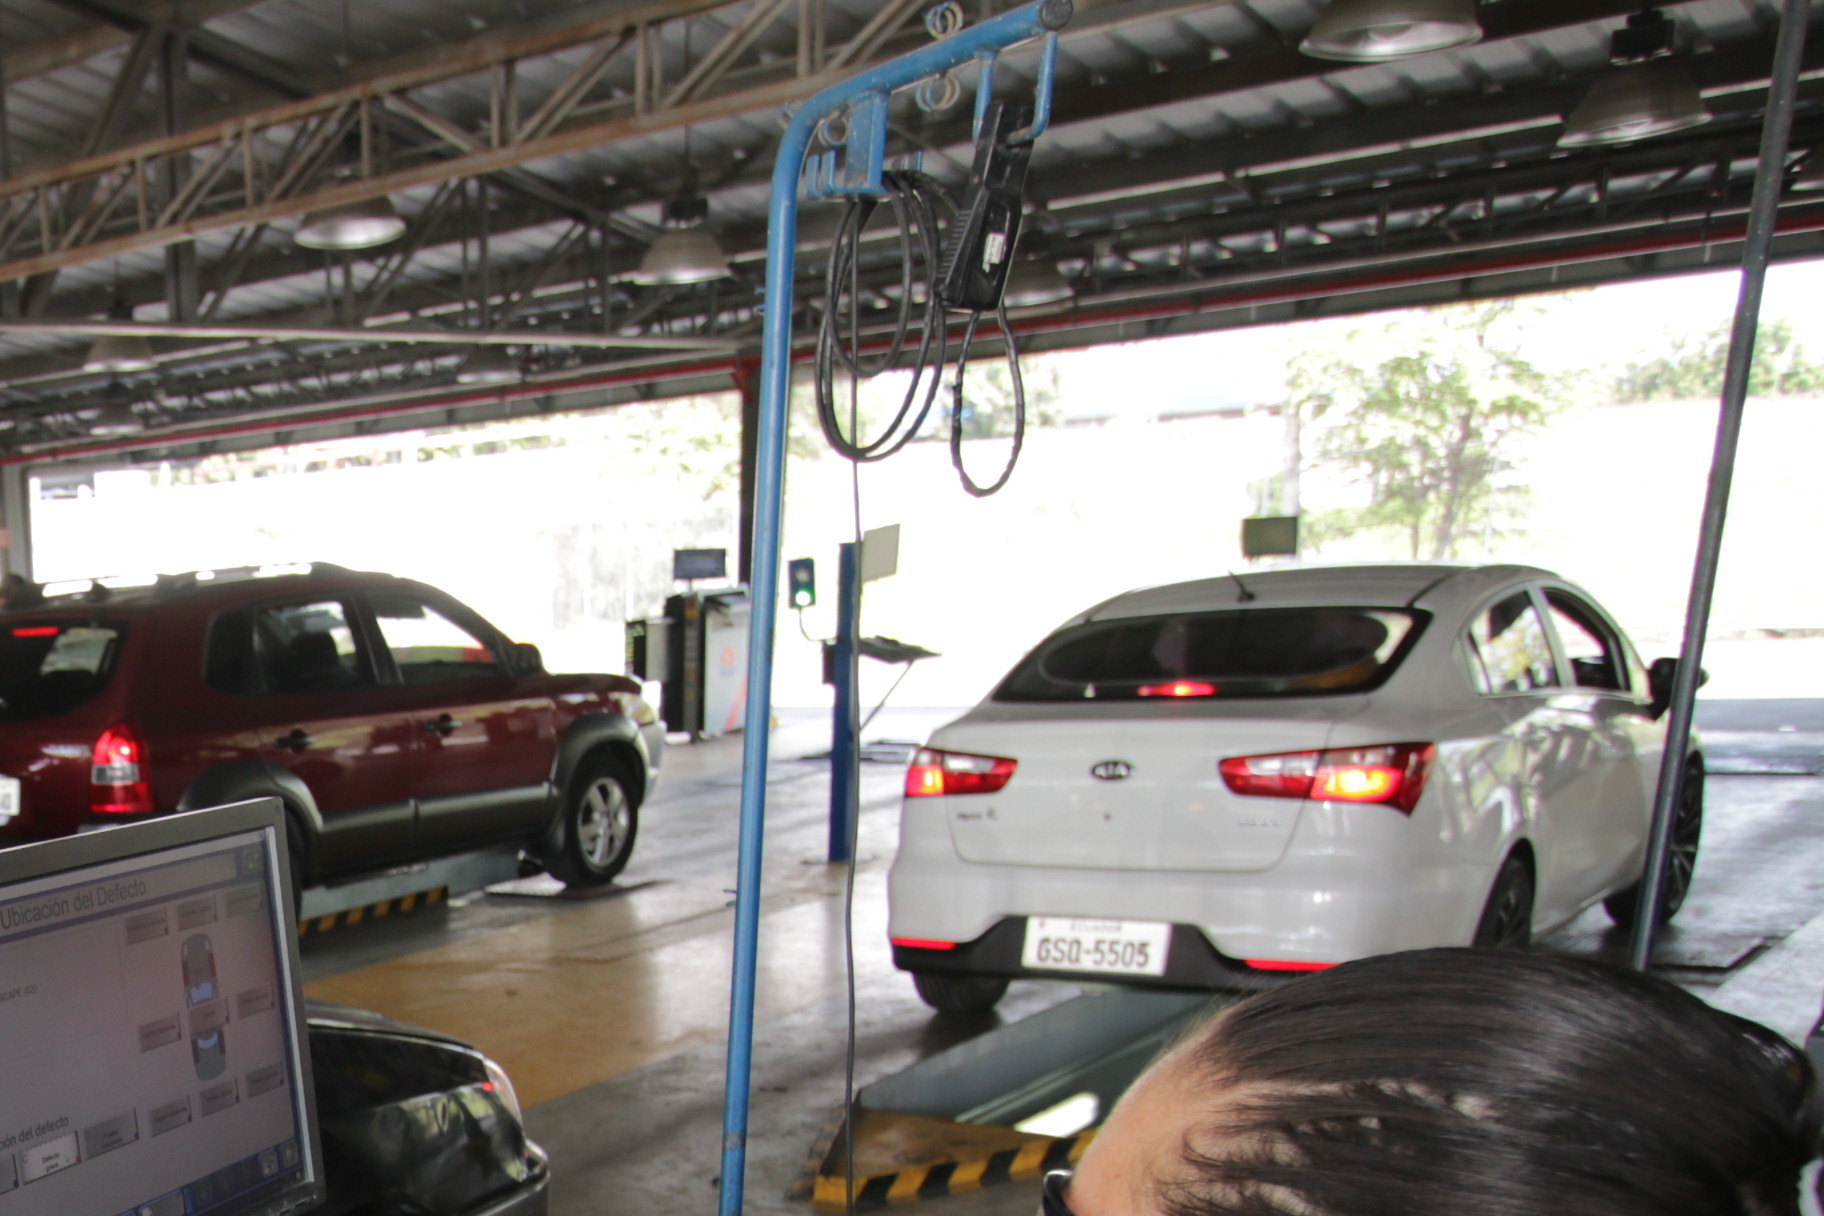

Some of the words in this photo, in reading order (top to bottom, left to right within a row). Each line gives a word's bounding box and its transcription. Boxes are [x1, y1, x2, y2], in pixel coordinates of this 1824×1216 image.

[0, 896, 69, 930] Ubicación
[73, 889, 94, 912] del
[97, 879, 147, 906] Defecto
[1036, 935, 1151, 969] GSQ-5505
[18, 1127, 34, 1143] del
[35, 1115, 70, 1137] defecto
